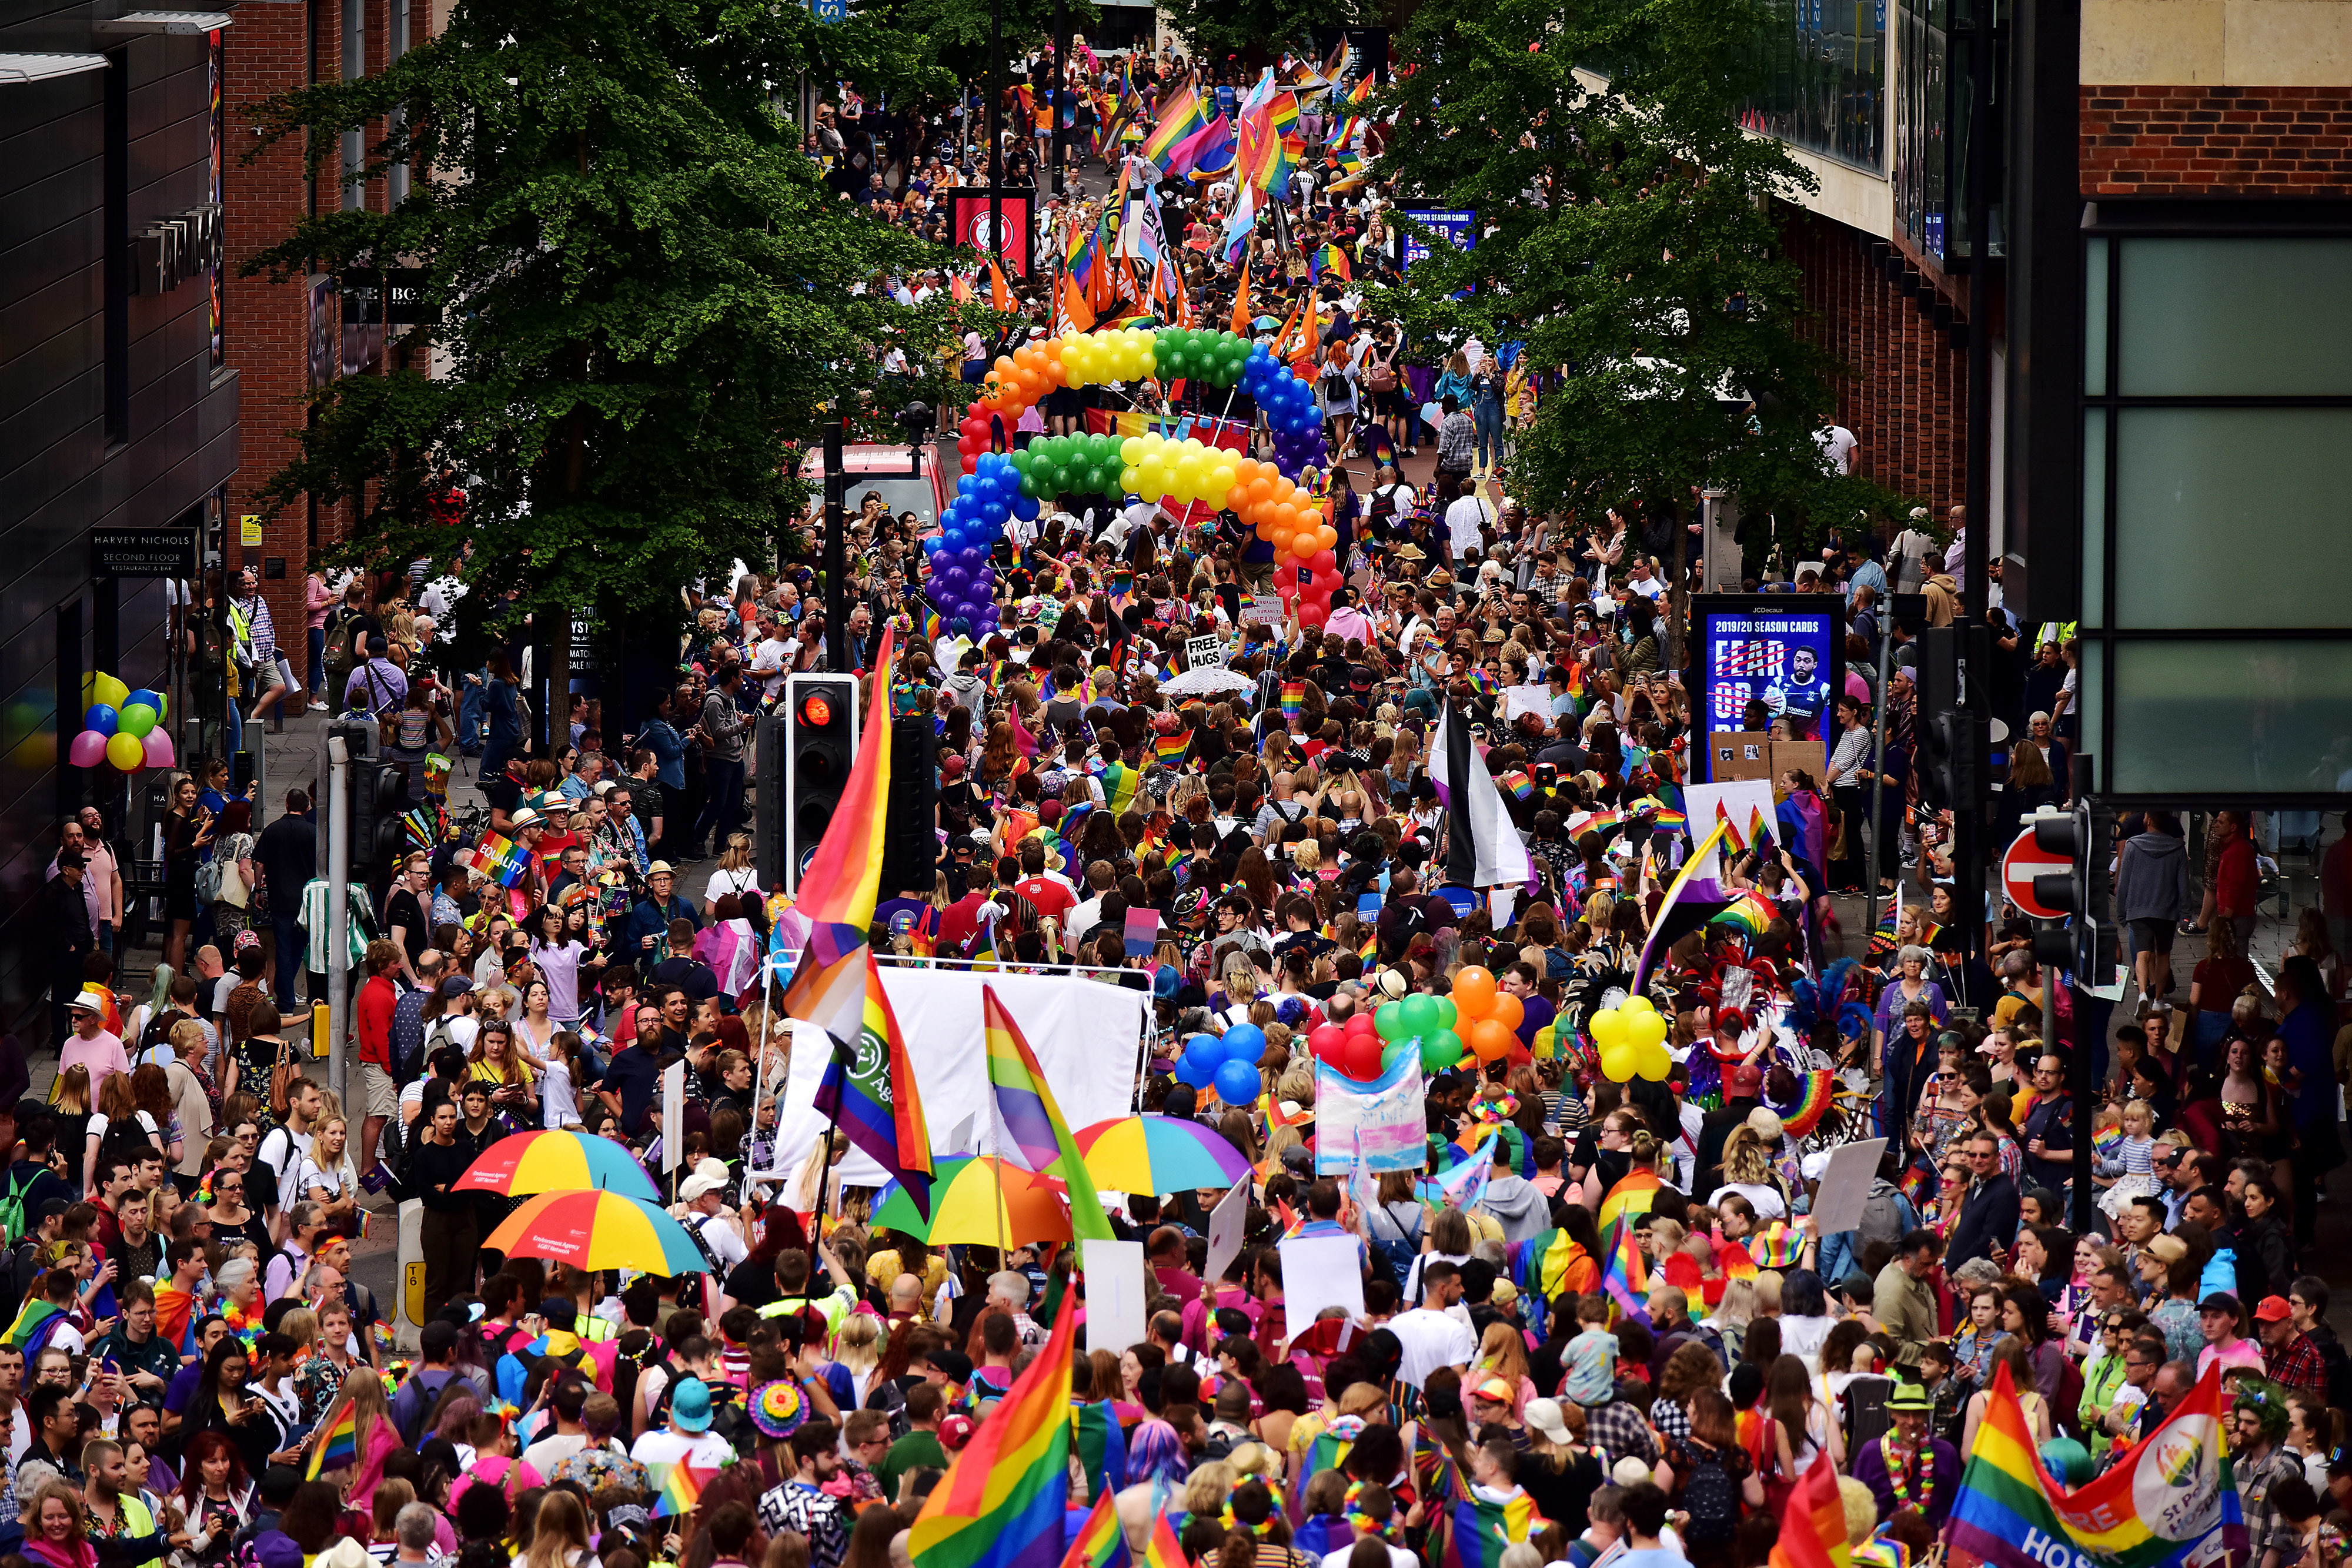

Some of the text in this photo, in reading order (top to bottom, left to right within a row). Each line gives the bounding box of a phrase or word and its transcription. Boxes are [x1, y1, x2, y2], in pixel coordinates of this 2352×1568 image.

[1716, 621, 1819, 633] 2019/20 SEASON CARDS
[1188, 638, 1217, 654] FREE
[1190, 651, 1221, 668] HUGS
[1715, 640, 1785, 677] FEAR
[569, 661, 584, 670] SALE
[1787, 706, 1813, 715] TOOGOOD
[479, 842, 526, 875] EQUALITY
[1358, 912, 1377, 922] URITY
[533, 1235, 580, 1251] Environment Agency
[537, 1242, 570, 1255] LGBT Network
[409, 1266, 417, 1275] T
[410, 1276, 417, 1286] 6
[296, 1354, 308, 1365] GMB
